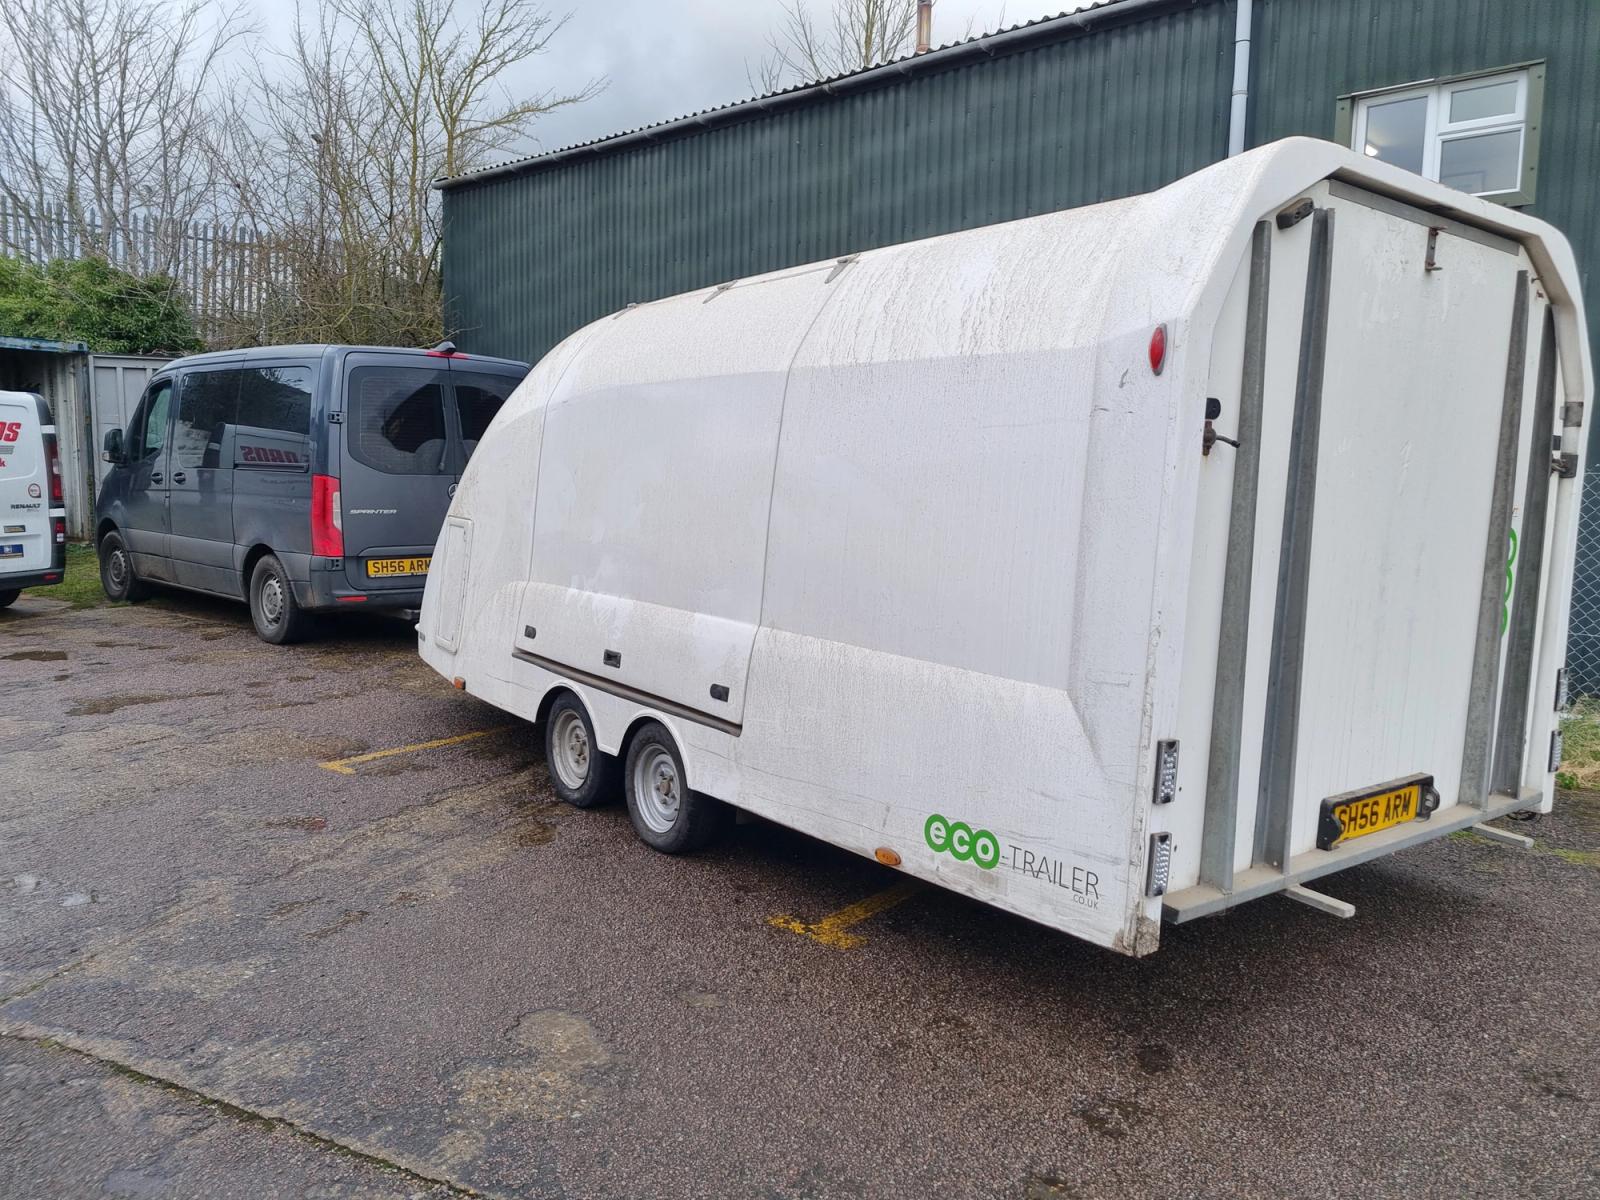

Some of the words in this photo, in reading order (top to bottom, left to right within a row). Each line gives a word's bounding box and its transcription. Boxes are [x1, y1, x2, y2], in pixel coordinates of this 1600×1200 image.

[372, 561, 406, 574] SH56
[1338, 800, 1380, 834] SH56
[1383, 791, 1412, 823] ARM
